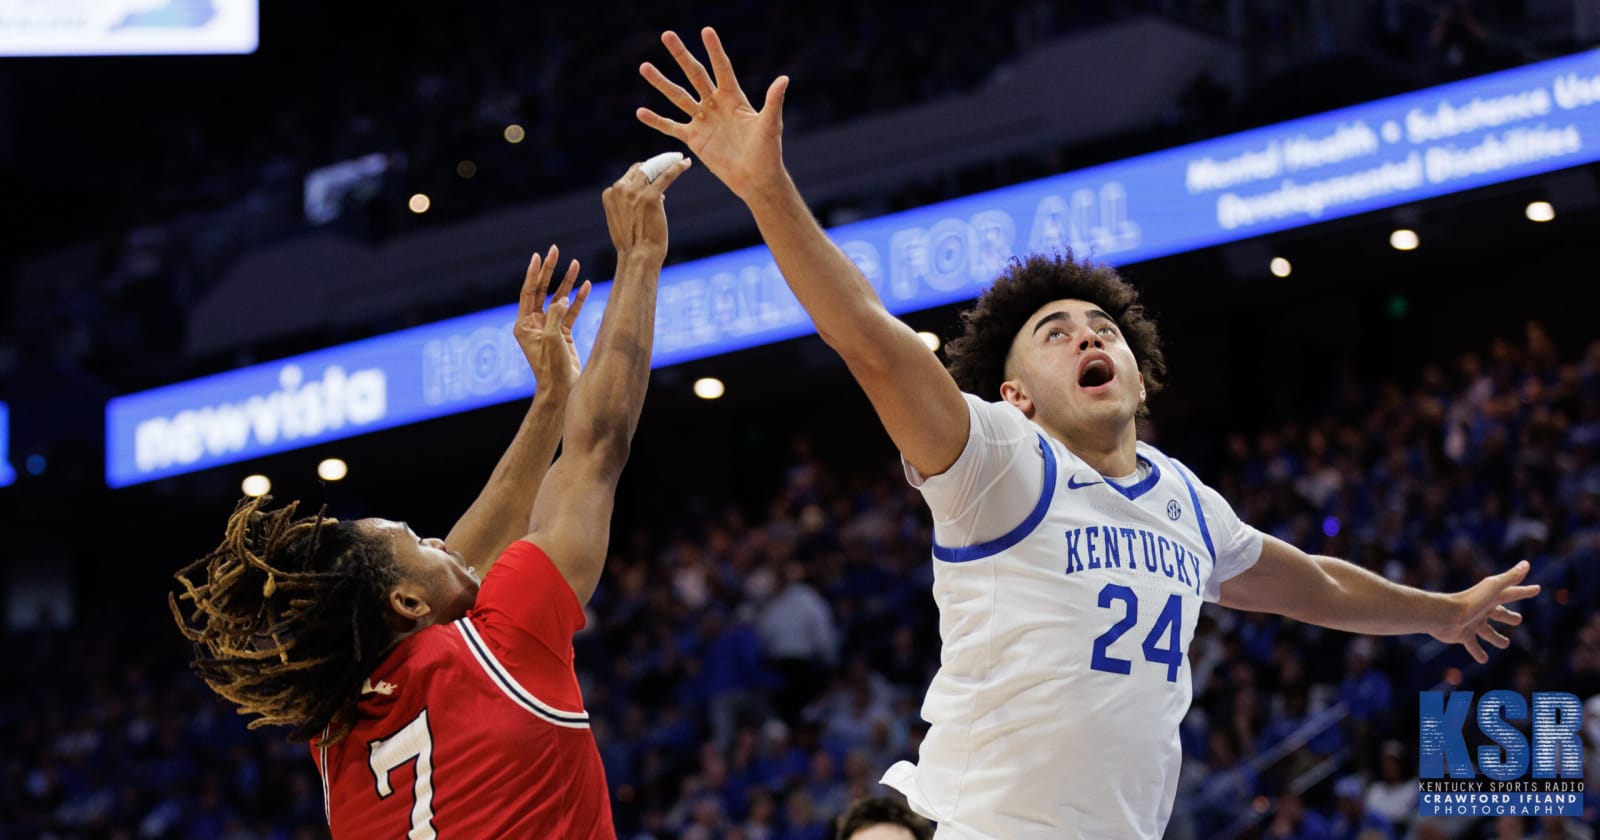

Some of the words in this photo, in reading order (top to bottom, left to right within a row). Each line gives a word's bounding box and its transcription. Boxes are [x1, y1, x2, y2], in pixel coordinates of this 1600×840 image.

[1283, 121, 1379, 172] Health
[422, 322, 536, 405] HOP
[889, 209, 1017, 300] FOR
[1027, 181, 1142, 259] ALL
[134, 364, 388, 472] newvista
[1065, 526, 1200, 596] KENTUCKY
[1090, 583, 1183, 683] 24
[368, 706, 439, 840] 7
